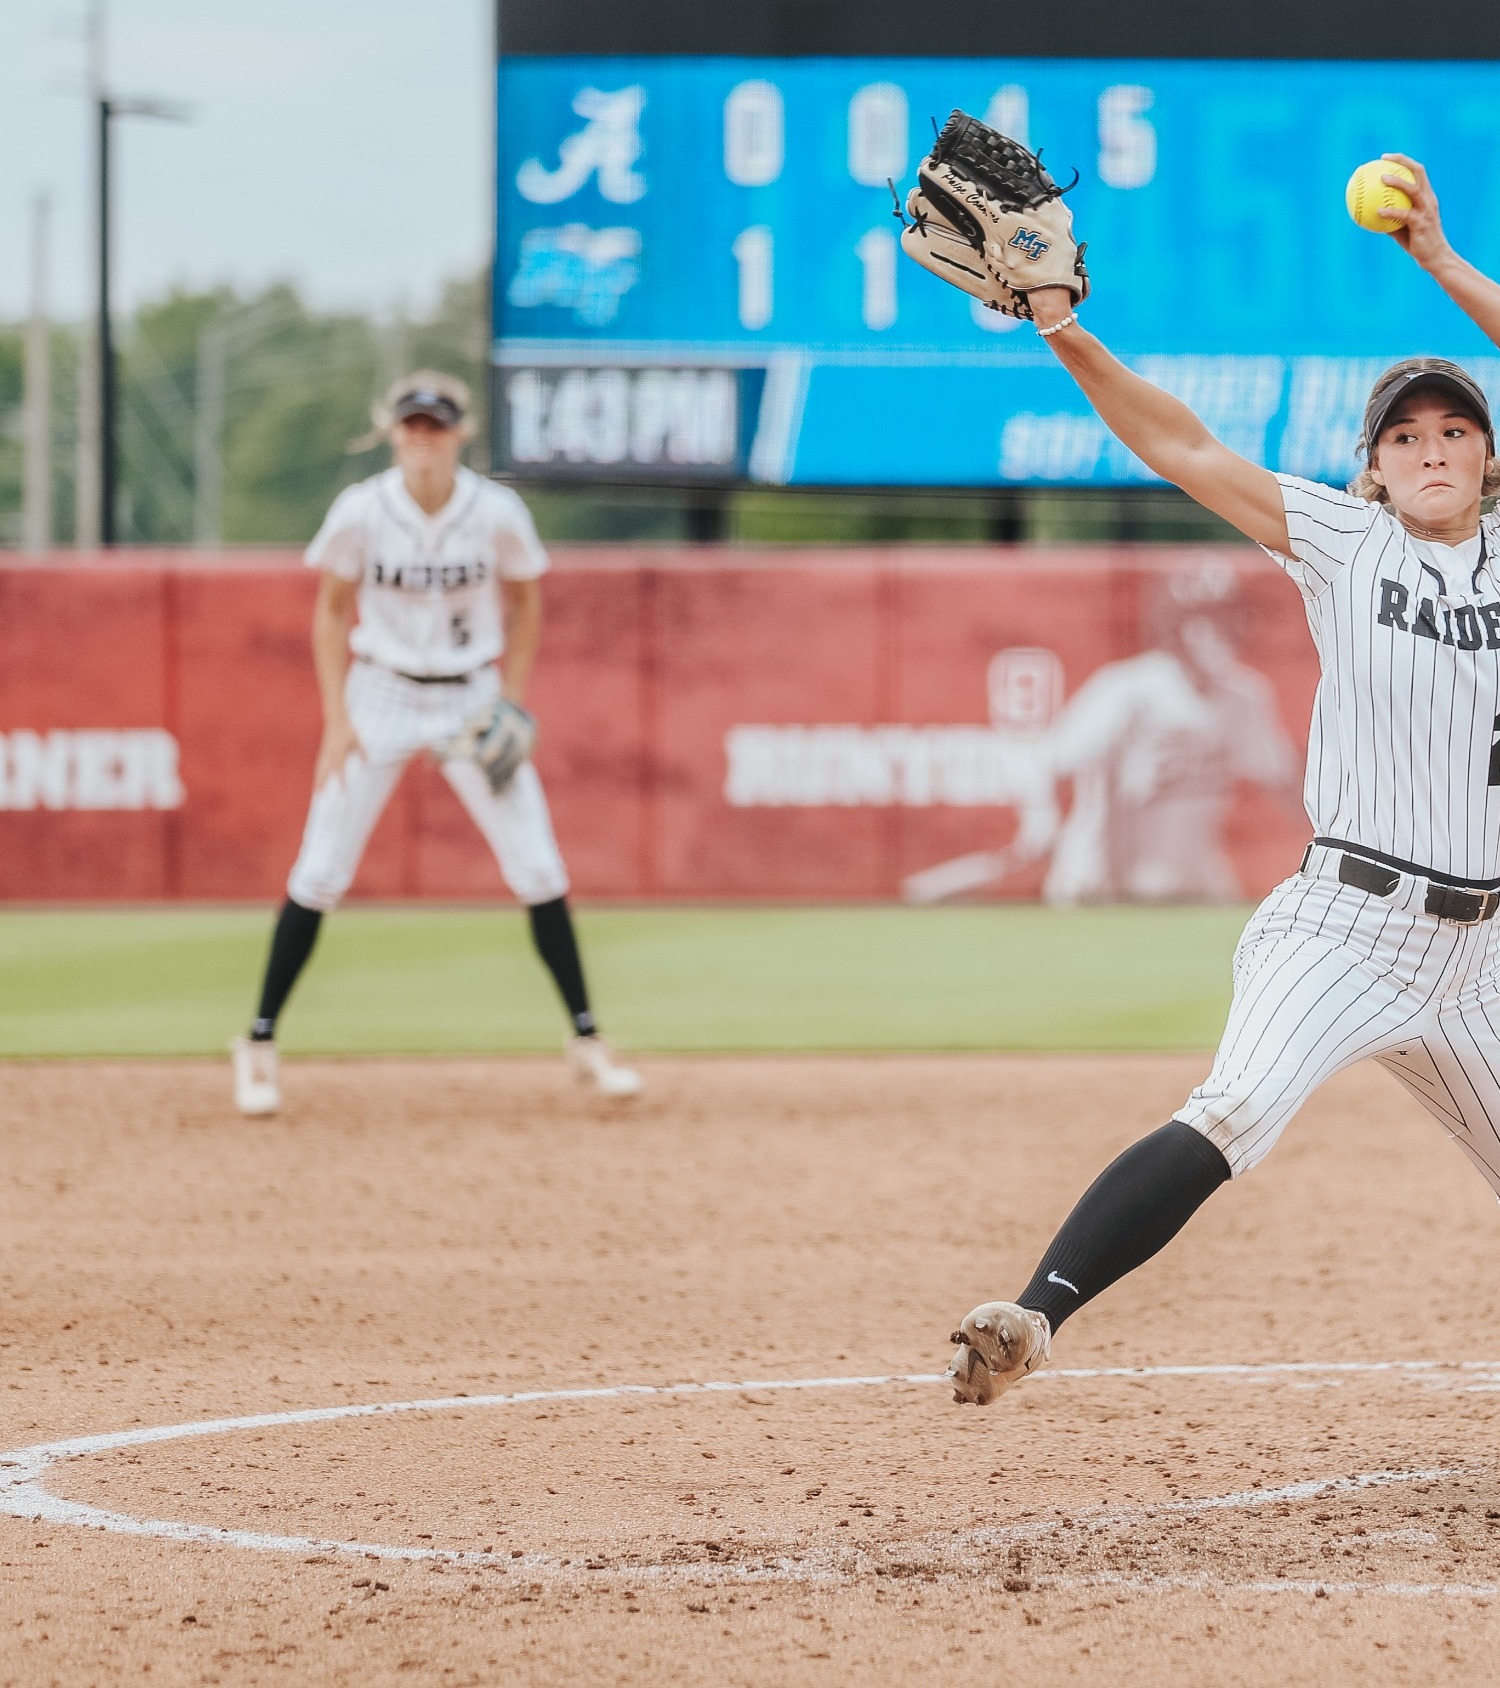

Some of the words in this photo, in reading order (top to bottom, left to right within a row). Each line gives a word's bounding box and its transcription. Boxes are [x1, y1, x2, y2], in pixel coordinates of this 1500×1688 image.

[722, 78, 786, 188] 0
[847, 81, 910, 188] 0
[1097, 84, 1157, 189] 5
[731, 224, 775, 331] 1
[854, 225, 899, 331] 1
[1009, 226, 1050, 262] MT
[0, 726, 188, 811] NER
